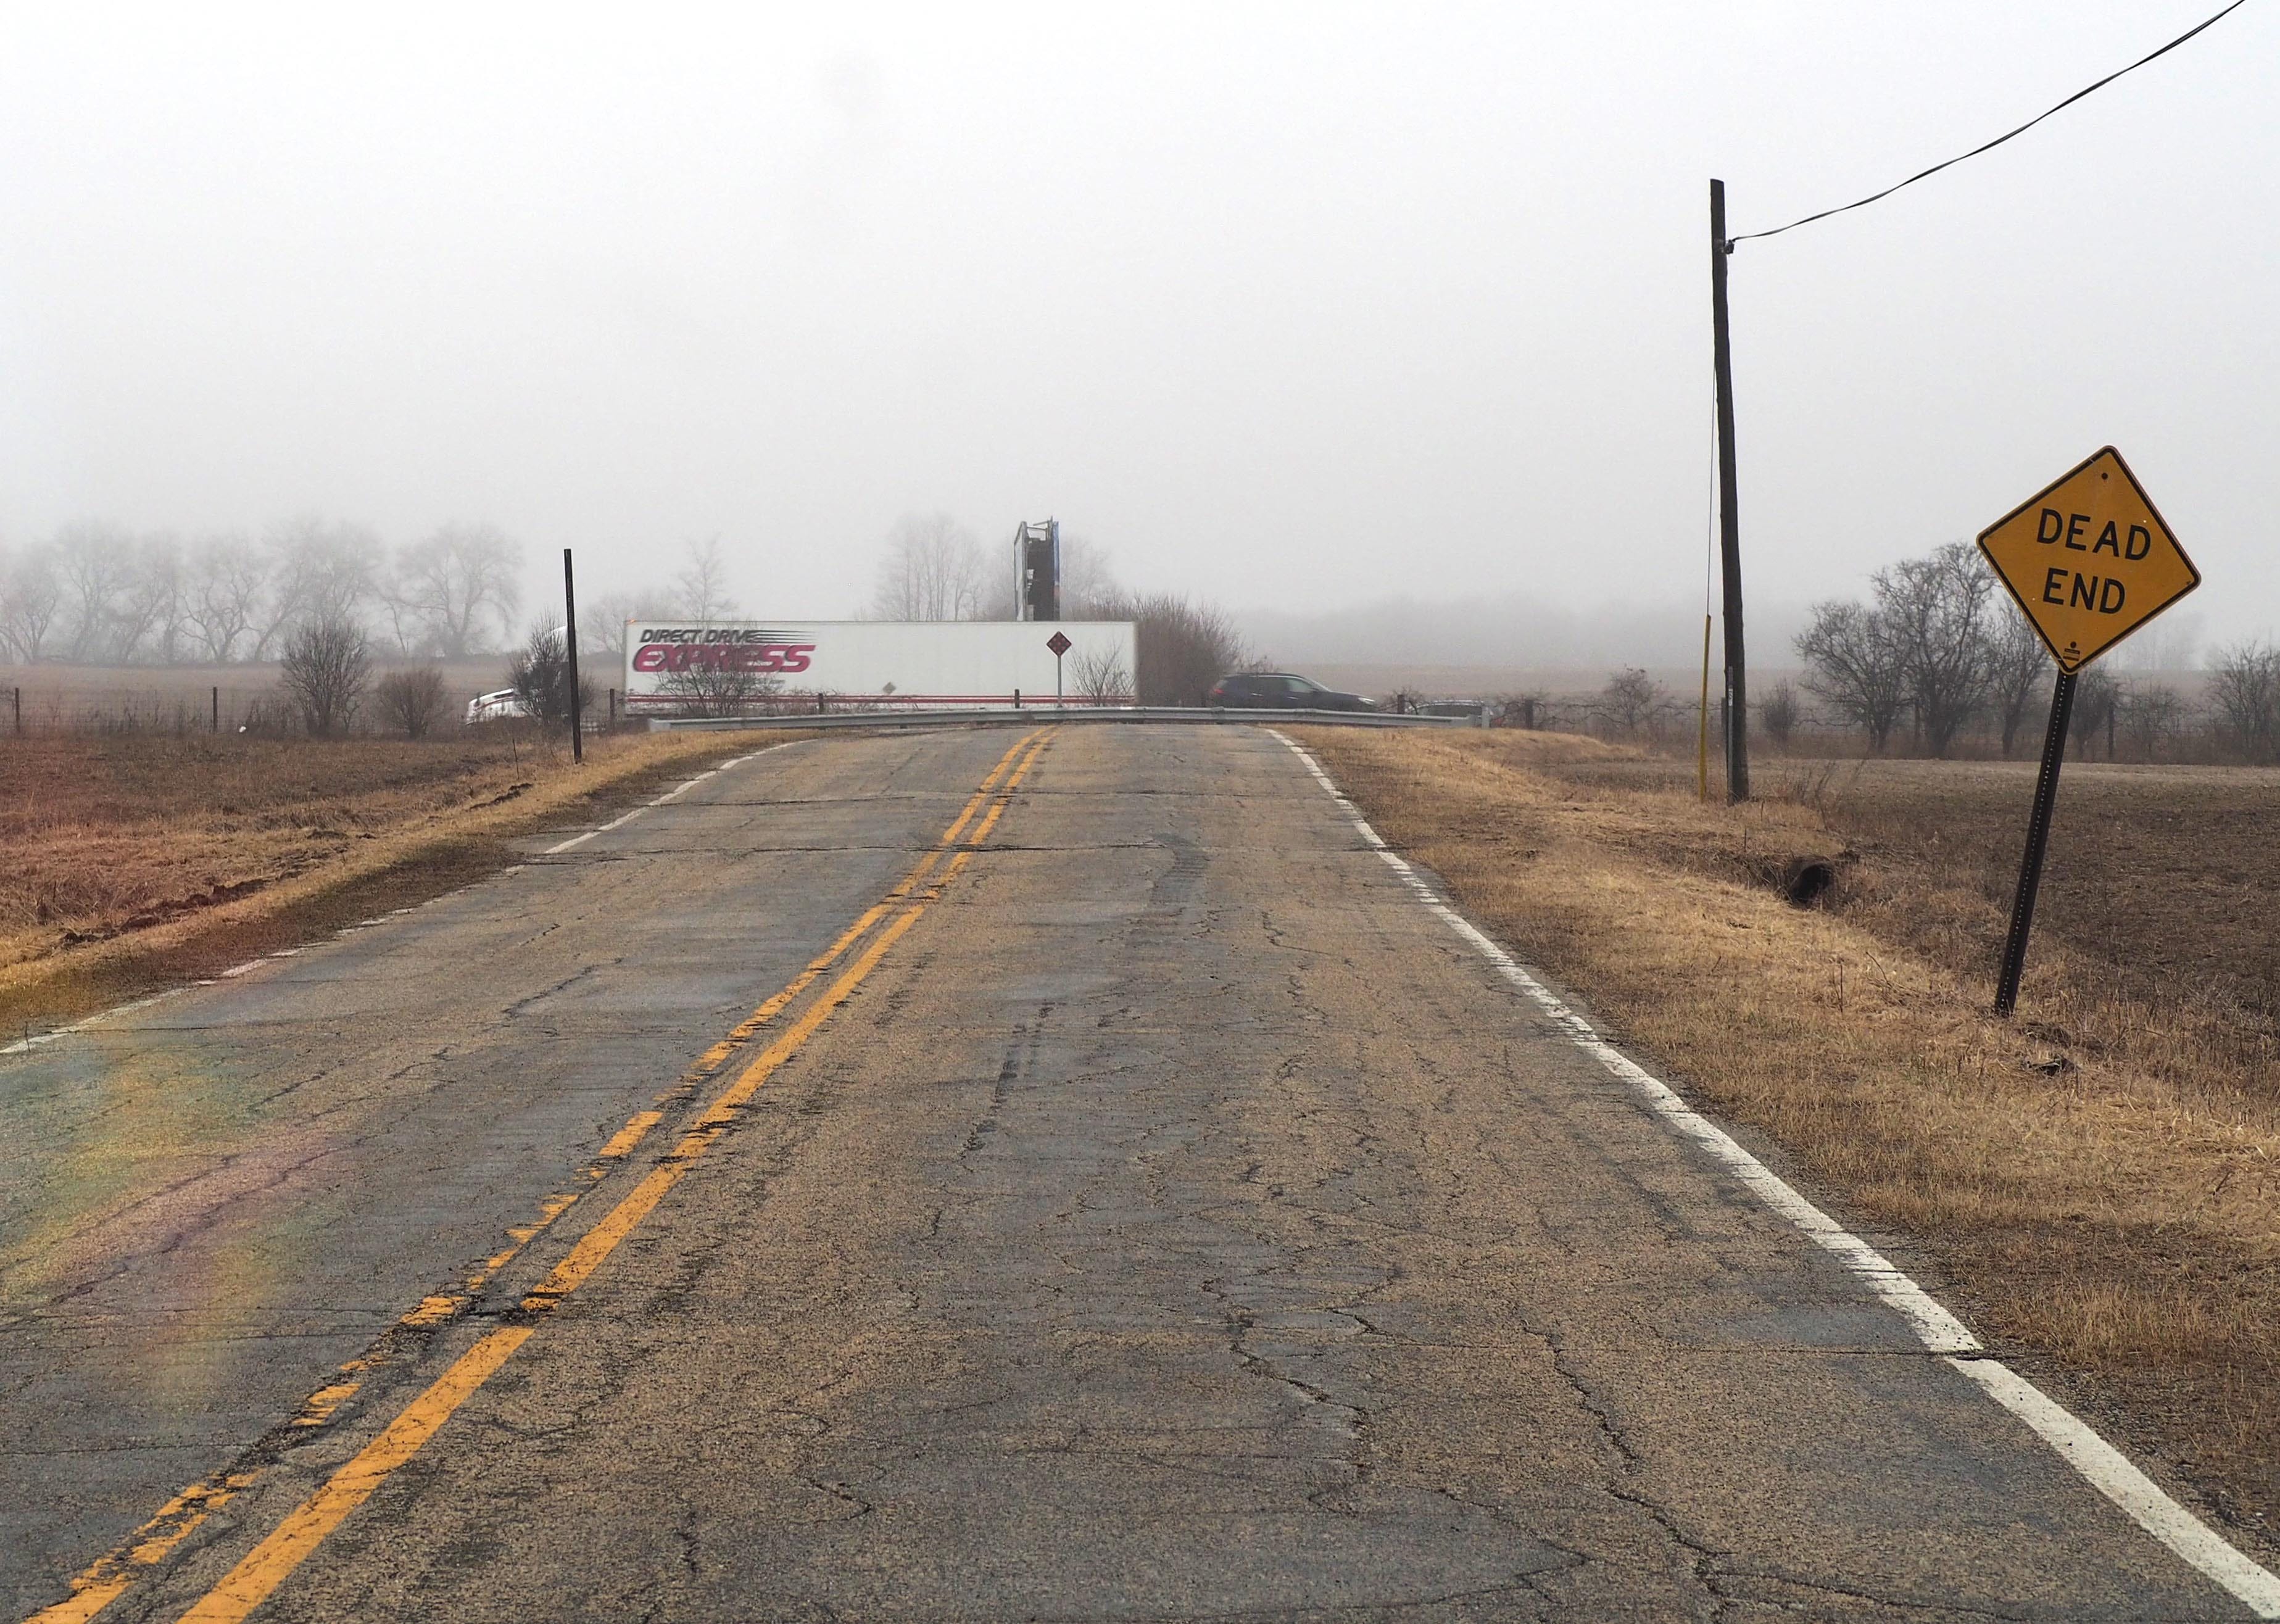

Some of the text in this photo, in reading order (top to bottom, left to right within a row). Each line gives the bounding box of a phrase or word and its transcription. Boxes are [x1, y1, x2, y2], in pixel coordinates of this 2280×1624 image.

[2036, 508, 2151, 561] DEAD
[2042, 567, 2125, 615] END
[640, 629, 756, 643] DIRECT DRIVE
[633, 644, 816, 673] EXPRESS
